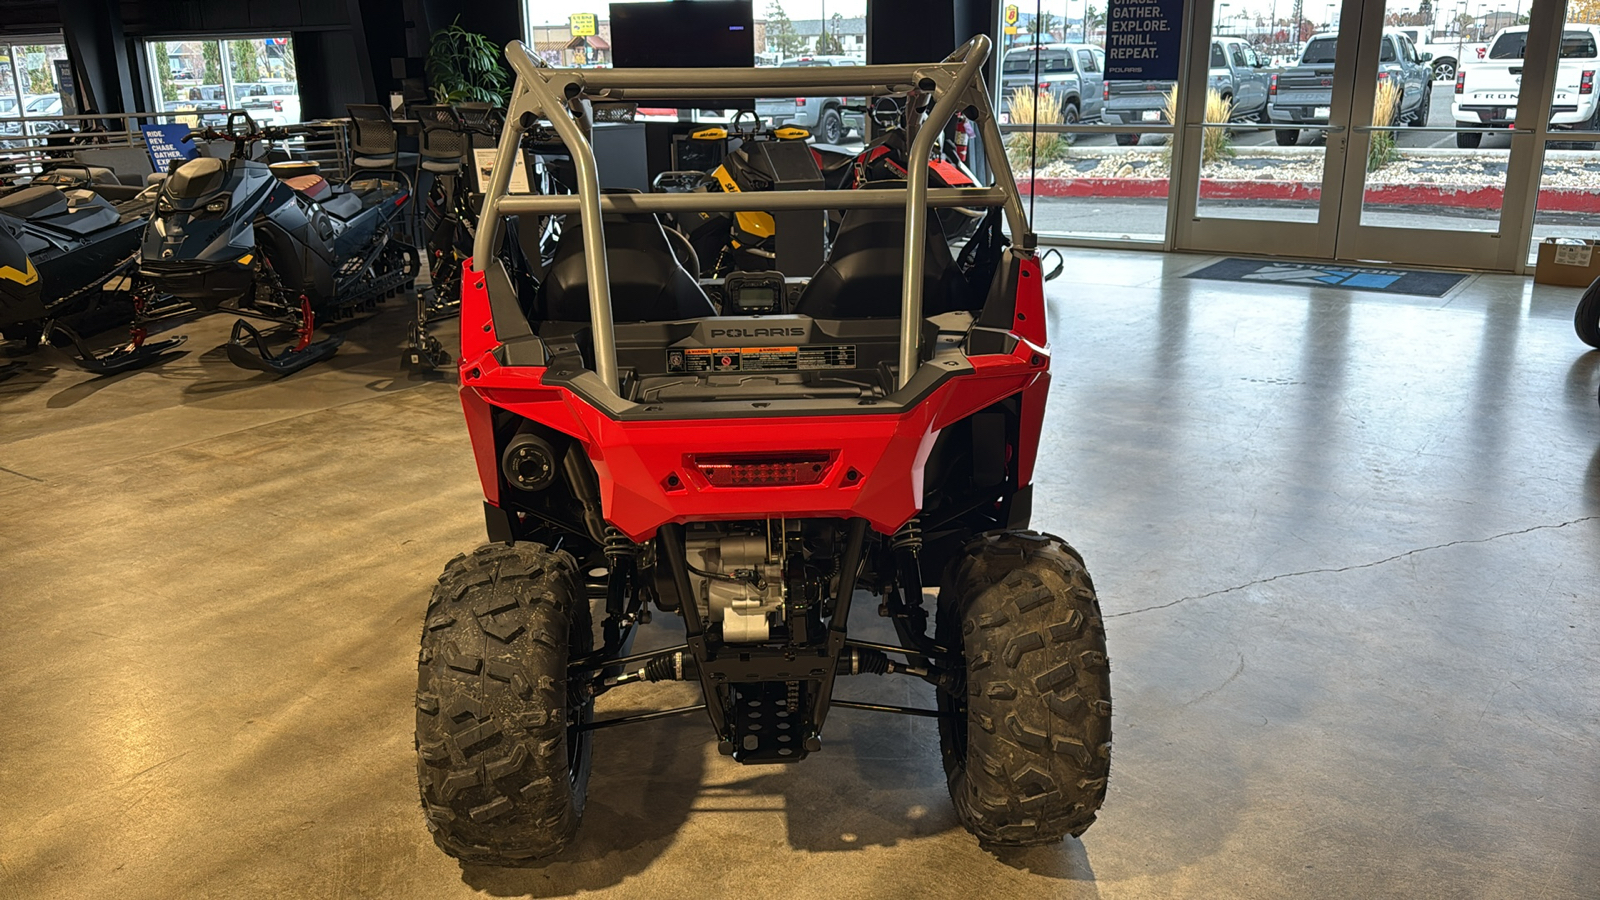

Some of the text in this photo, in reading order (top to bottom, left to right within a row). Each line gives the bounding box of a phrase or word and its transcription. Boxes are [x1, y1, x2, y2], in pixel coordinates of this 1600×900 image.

[1008, 10, 1015, 20] 8
[1113, 7, 1163, 18] GATHER.
[1112, 20, 1171, 31] EXPLORE.
[1111, 34, 1157, 46] THRILL.
[1110, 48, 1159, 59] REPEAT.
[151, 144, 177, 152] CHASE.
[154, 151, 183, 159] GATHER.
[710, 327, 806, 339] POLARIS
